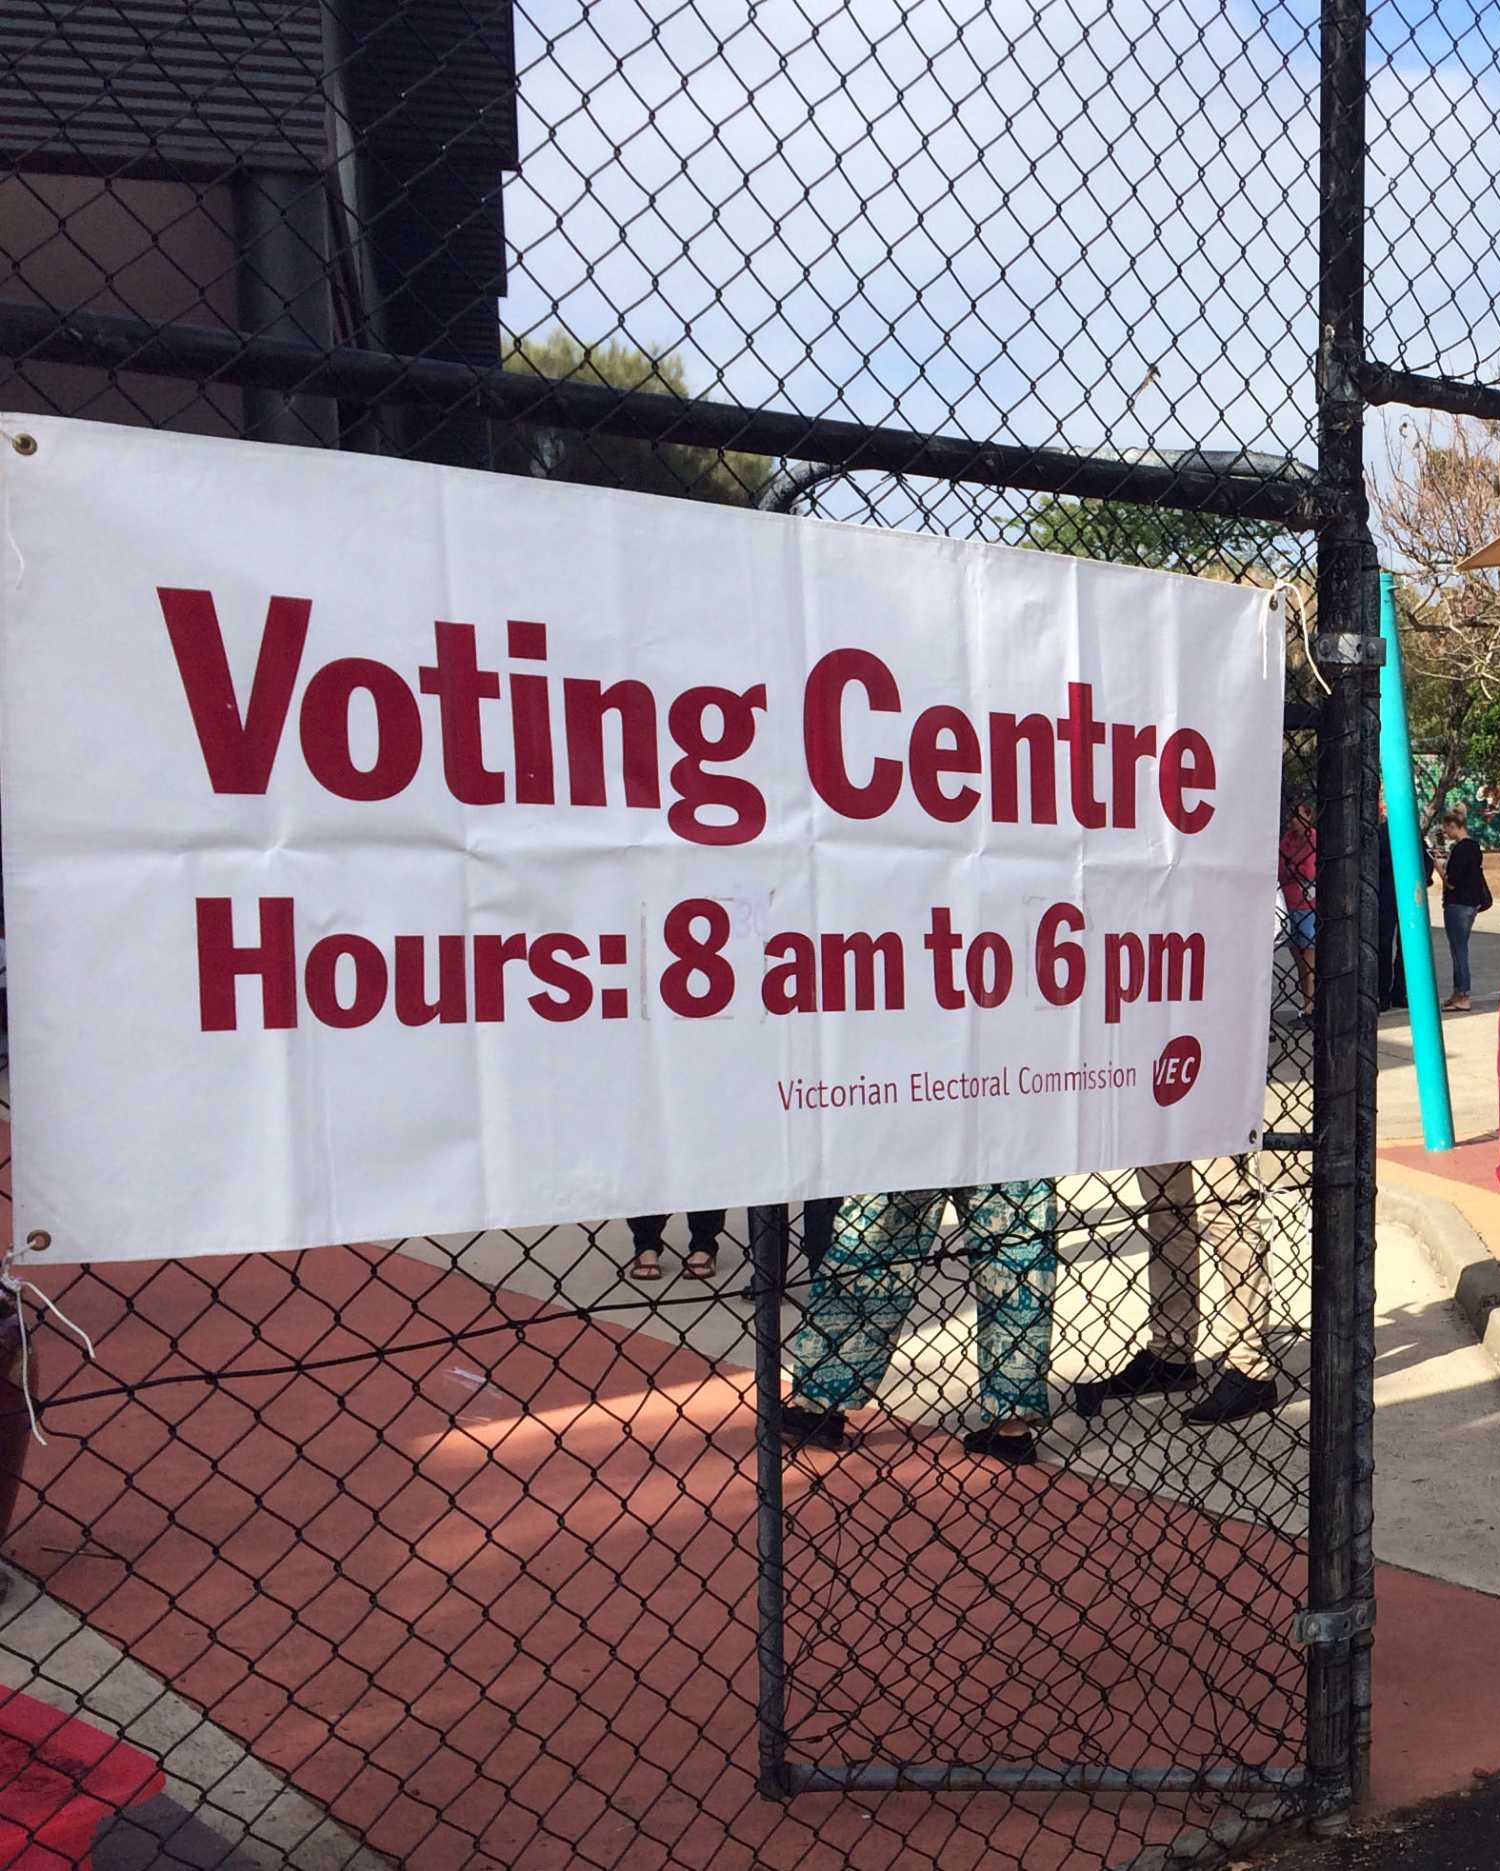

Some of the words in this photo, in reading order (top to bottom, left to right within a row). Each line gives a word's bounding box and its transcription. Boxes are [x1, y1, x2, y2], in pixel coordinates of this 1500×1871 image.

[156, 587, 767, 845] Voting
[804, 648, 1216, 834] Centre
[196, 897, 629, 1032] Hours:
[659, 897, 736, 1019] 8
[762, 930, 904, 1014] am
[925, 906, 1013, 1009] to
[1034, 901, 1085, 1006] 6
[1105, 929, 1206, 1023] pm
[777, 1074, 898, 1111] Victorian
[911, 1066, 1010, 1102] Electoral
[1018, 1060, 1137, 1095] Commission
[1152, 1055, 1197, 1086] VEC
